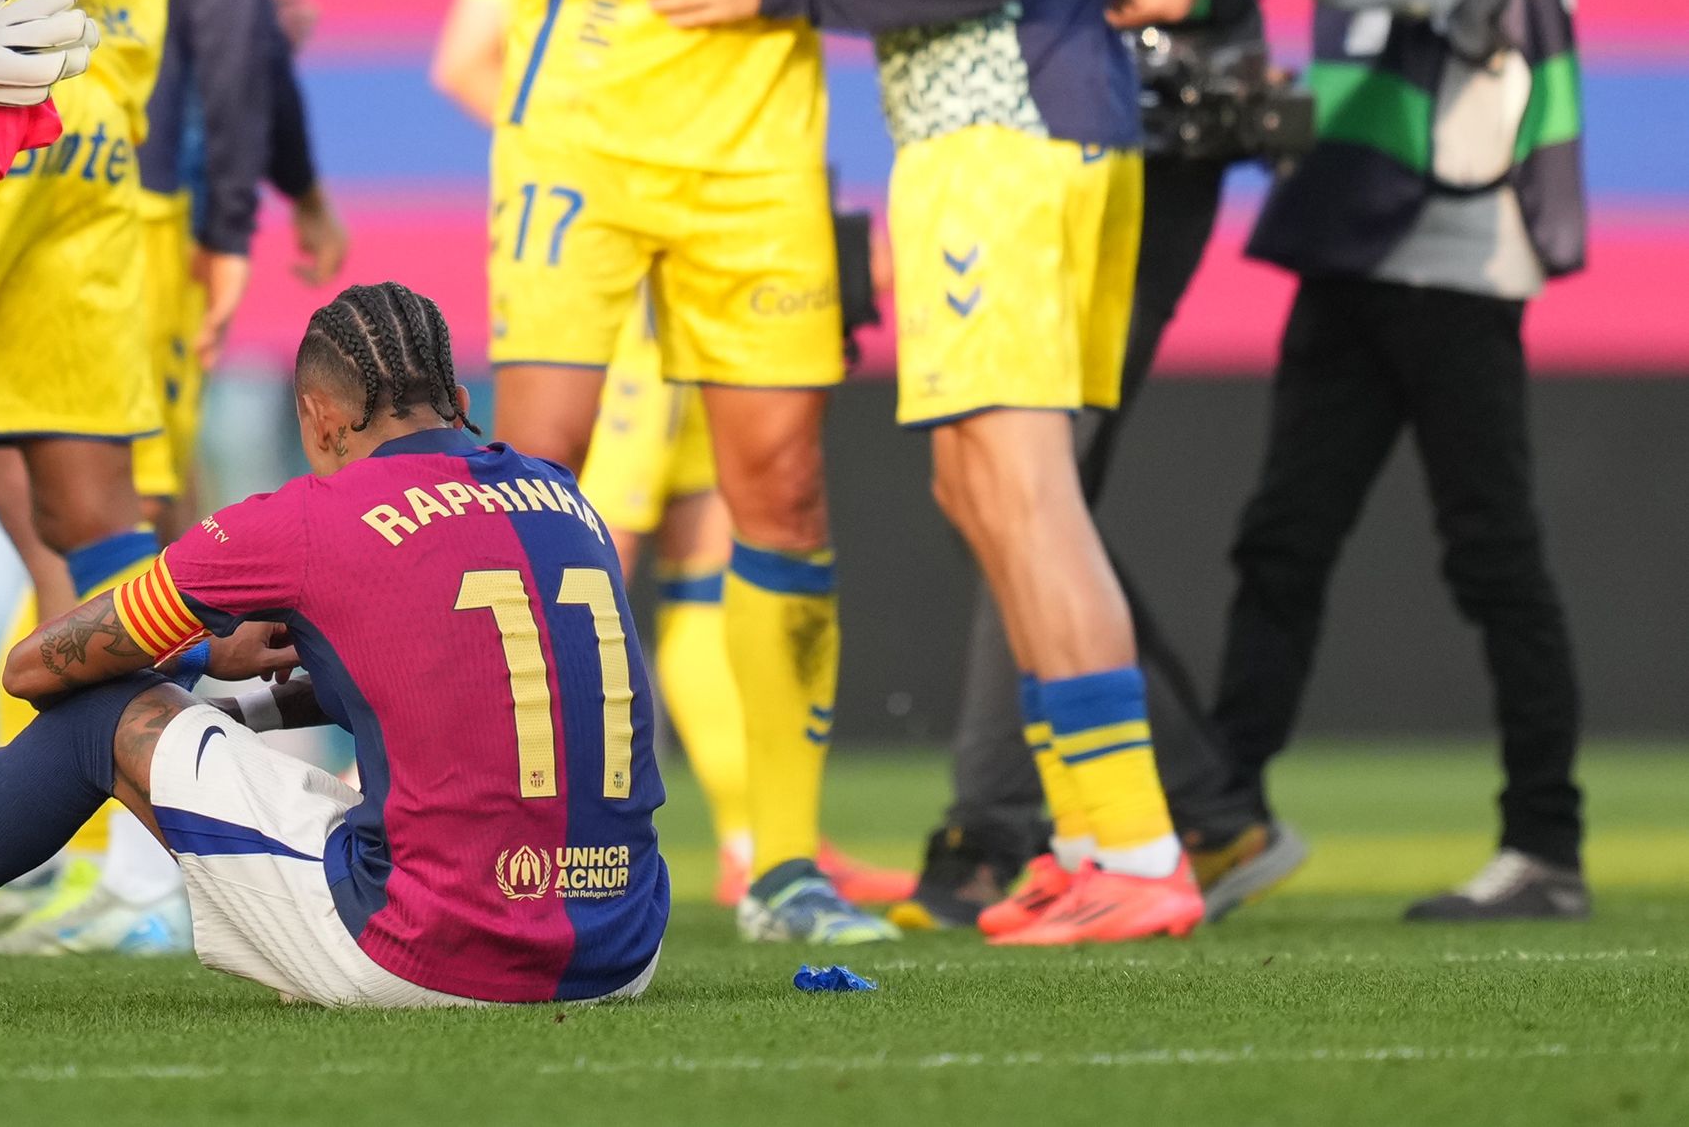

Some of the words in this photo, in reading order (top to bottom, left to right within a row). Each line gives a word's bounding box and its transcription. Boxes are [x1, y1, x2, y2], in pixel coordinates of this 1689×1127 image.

[513, 183, 585, 268] 17
[360, 478, 606, 547] RAPHINHA
[453, 567, 634, 799] 11
[554, 867, 629, 889] ACNUR
[556, 845, 629, 867] UNHCR
[555, 890, 567, 898] The
[568, 890, 579, 898] UN
